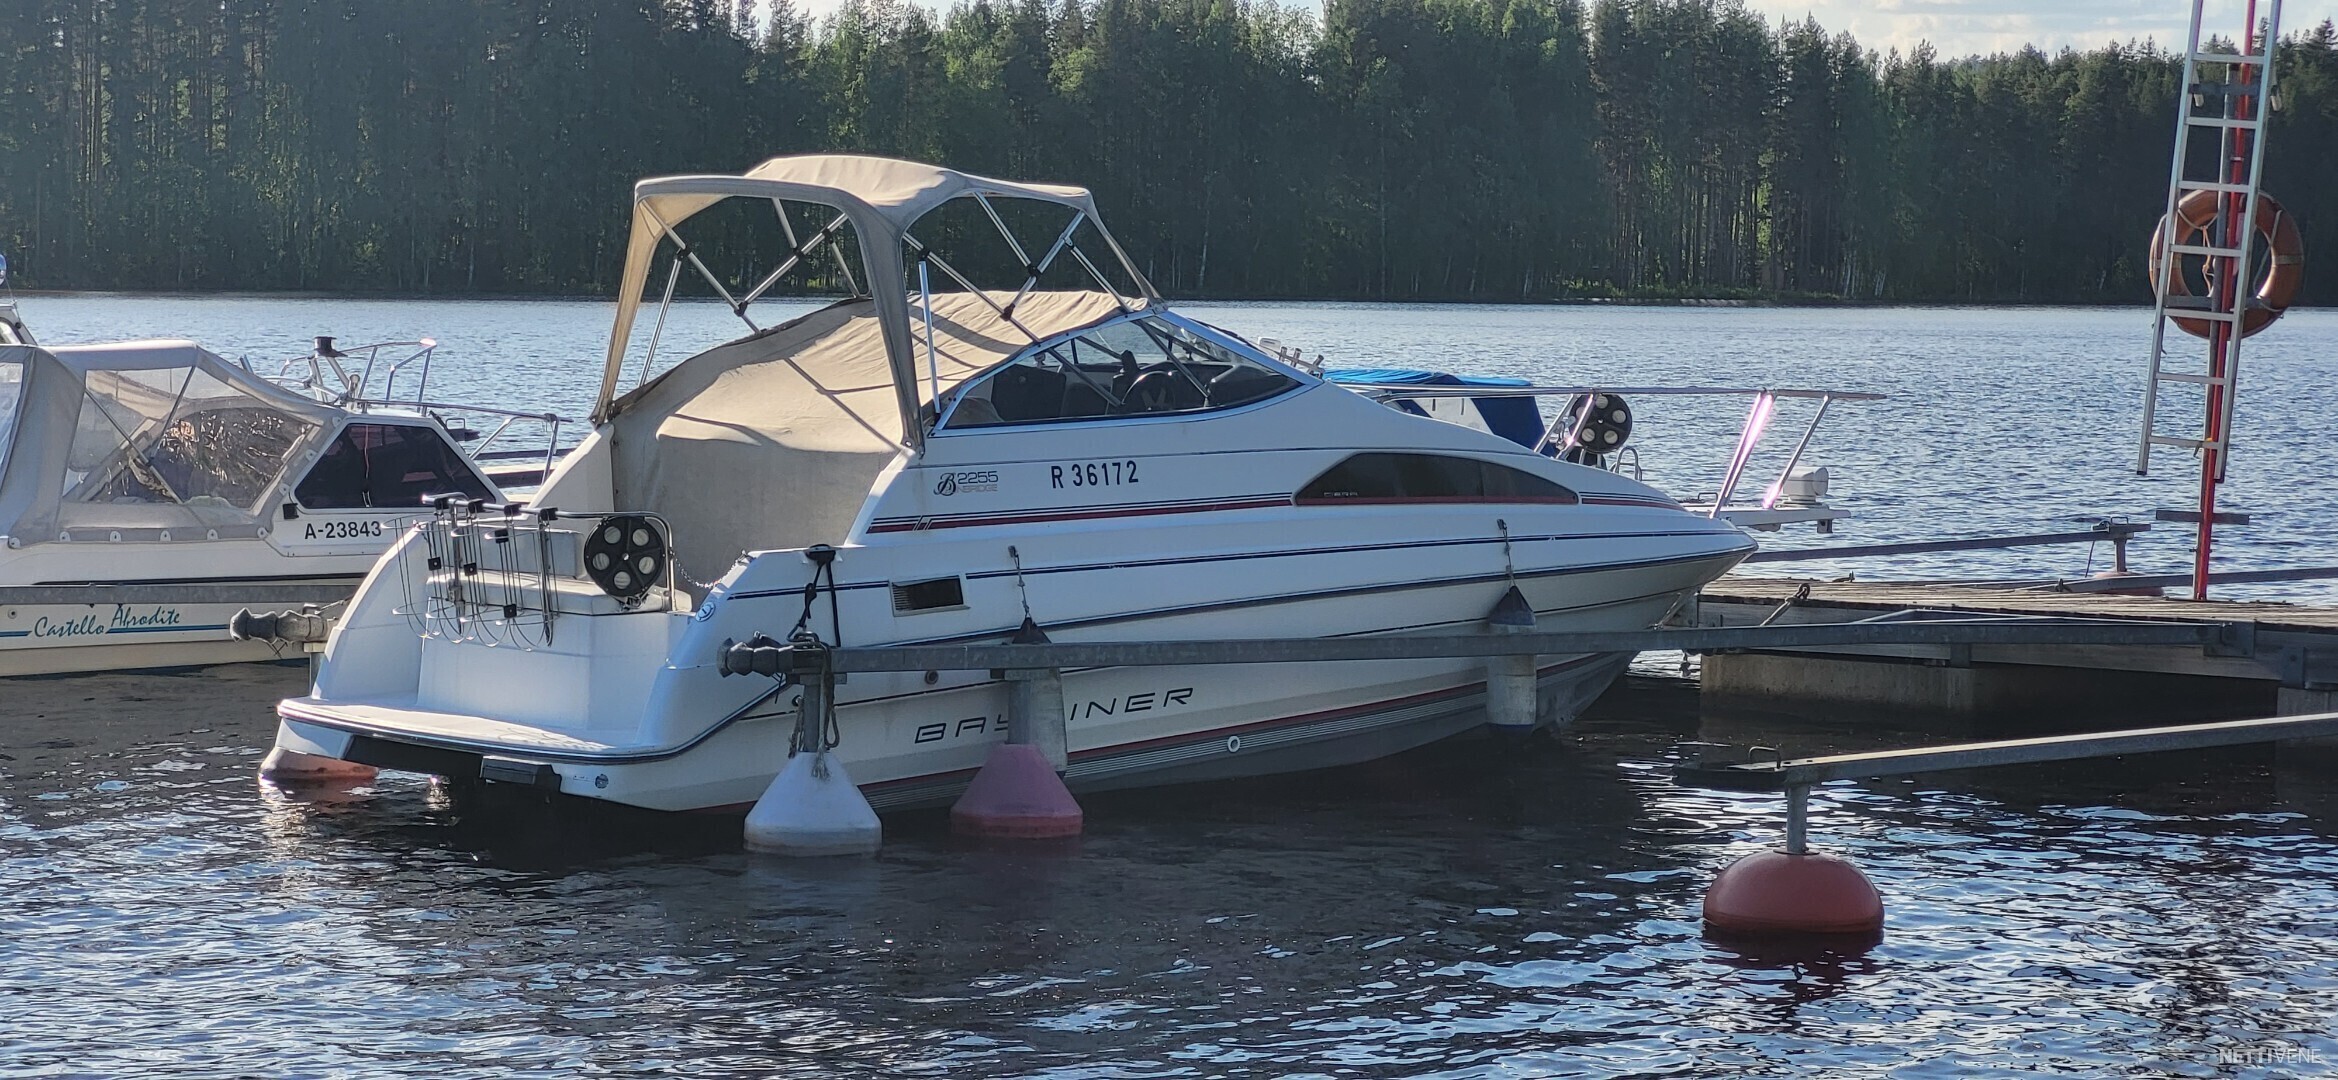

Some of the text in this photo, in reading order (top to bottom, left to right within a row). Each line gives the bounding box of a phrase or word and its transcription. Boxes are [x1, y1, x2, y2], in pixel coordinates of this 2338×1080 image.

[957, 470, 999, 484] 2255
[1051, 460, 1139, 488] R 36172
[304, 520, 382, 540] A-23843
[34, 605, 180, 637] Castello Afrodite
[914, 687, 1194, 744] BAINER
